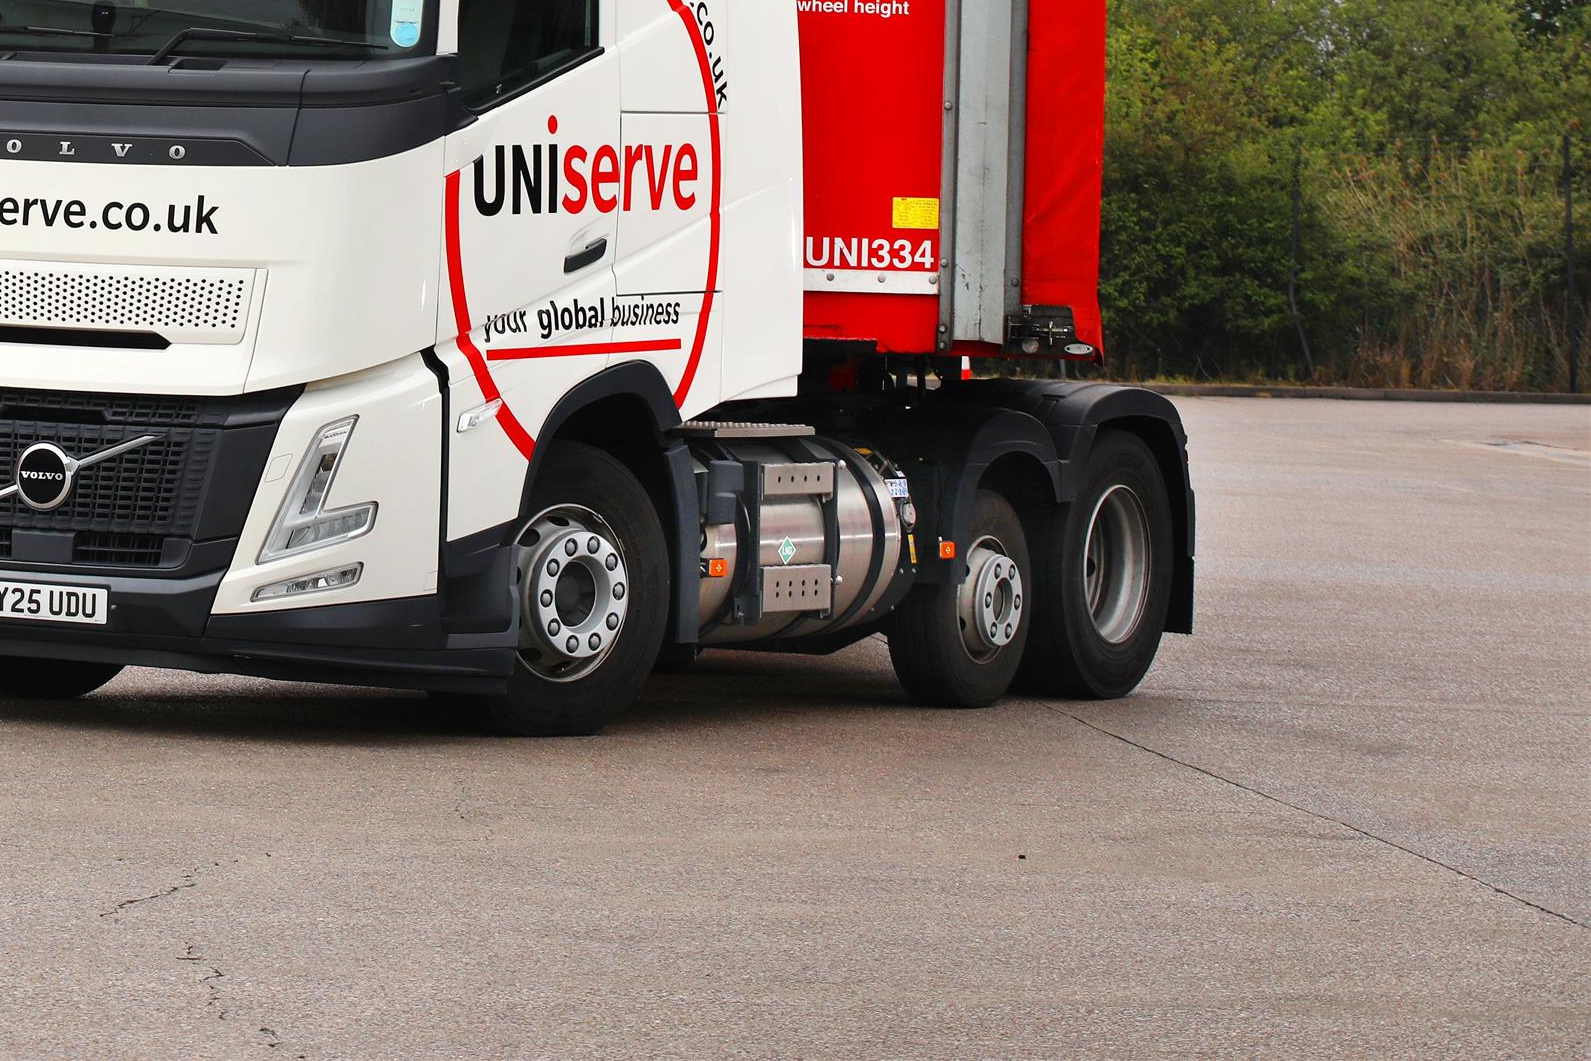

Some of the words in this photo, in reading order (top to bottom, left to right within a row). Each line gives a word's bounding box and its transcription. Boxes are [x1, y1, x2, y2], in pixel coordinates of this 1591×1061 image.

[854, 0, 910, 18] height
[806, 236, 935, 269] UNI334
[484, 308, 527, 343] your
[537, 297, 604, 339] global
[609, 294, 680, 327] business
[20, 470, 64, 481] VOLVO
[49, 590, 96, 618] UDU
